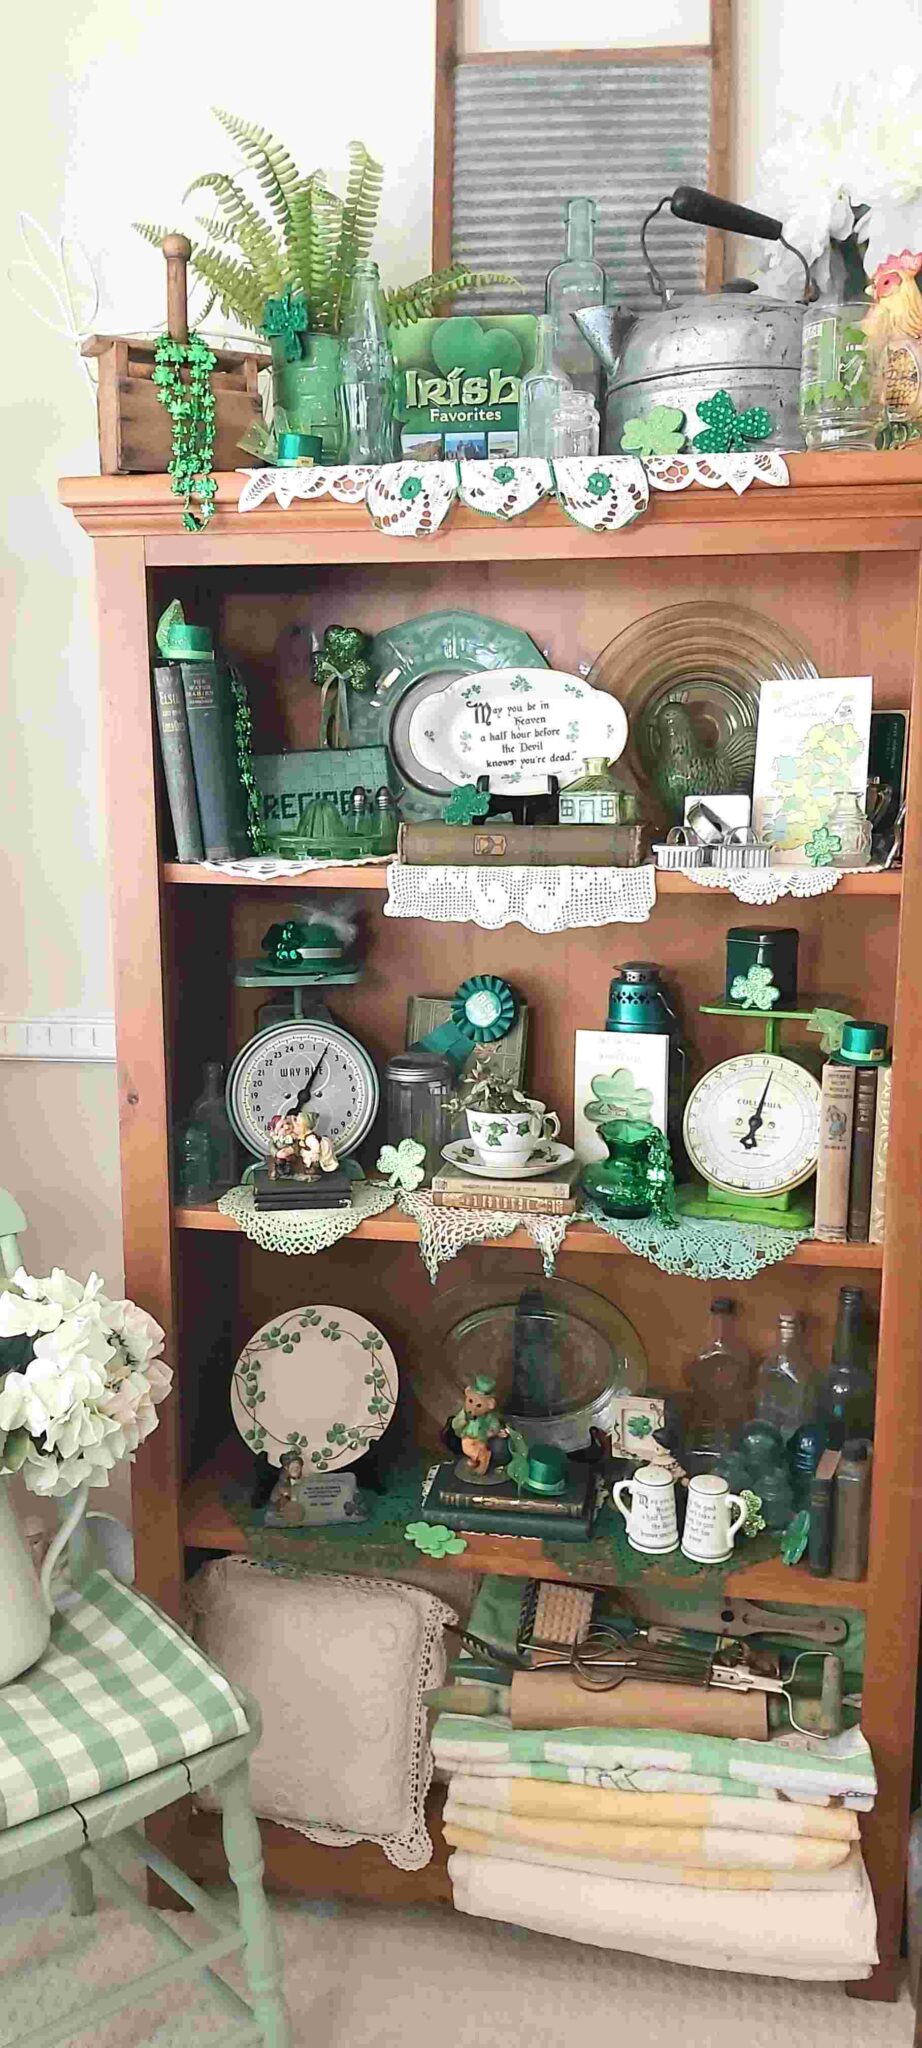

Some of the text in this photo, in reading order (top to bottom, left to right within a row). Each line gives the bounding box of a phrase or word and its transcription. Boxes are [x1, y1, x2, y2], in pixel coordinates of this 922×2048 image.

[430, 408, 502, 422] Favorites
[466, 700, 550, 726] May you be in
[489, 731, 508, 741] half
[511, 730, 531, 740] hour
[534, 727, 561, 737] before
[502, 742, 544, 754] the Devil
[486, 760, 517, 768] knows
[520, 755, 546, 769] you're
[273, 1051, 283, 1059] 23
[280, 1068, 301, 1077] WAY
